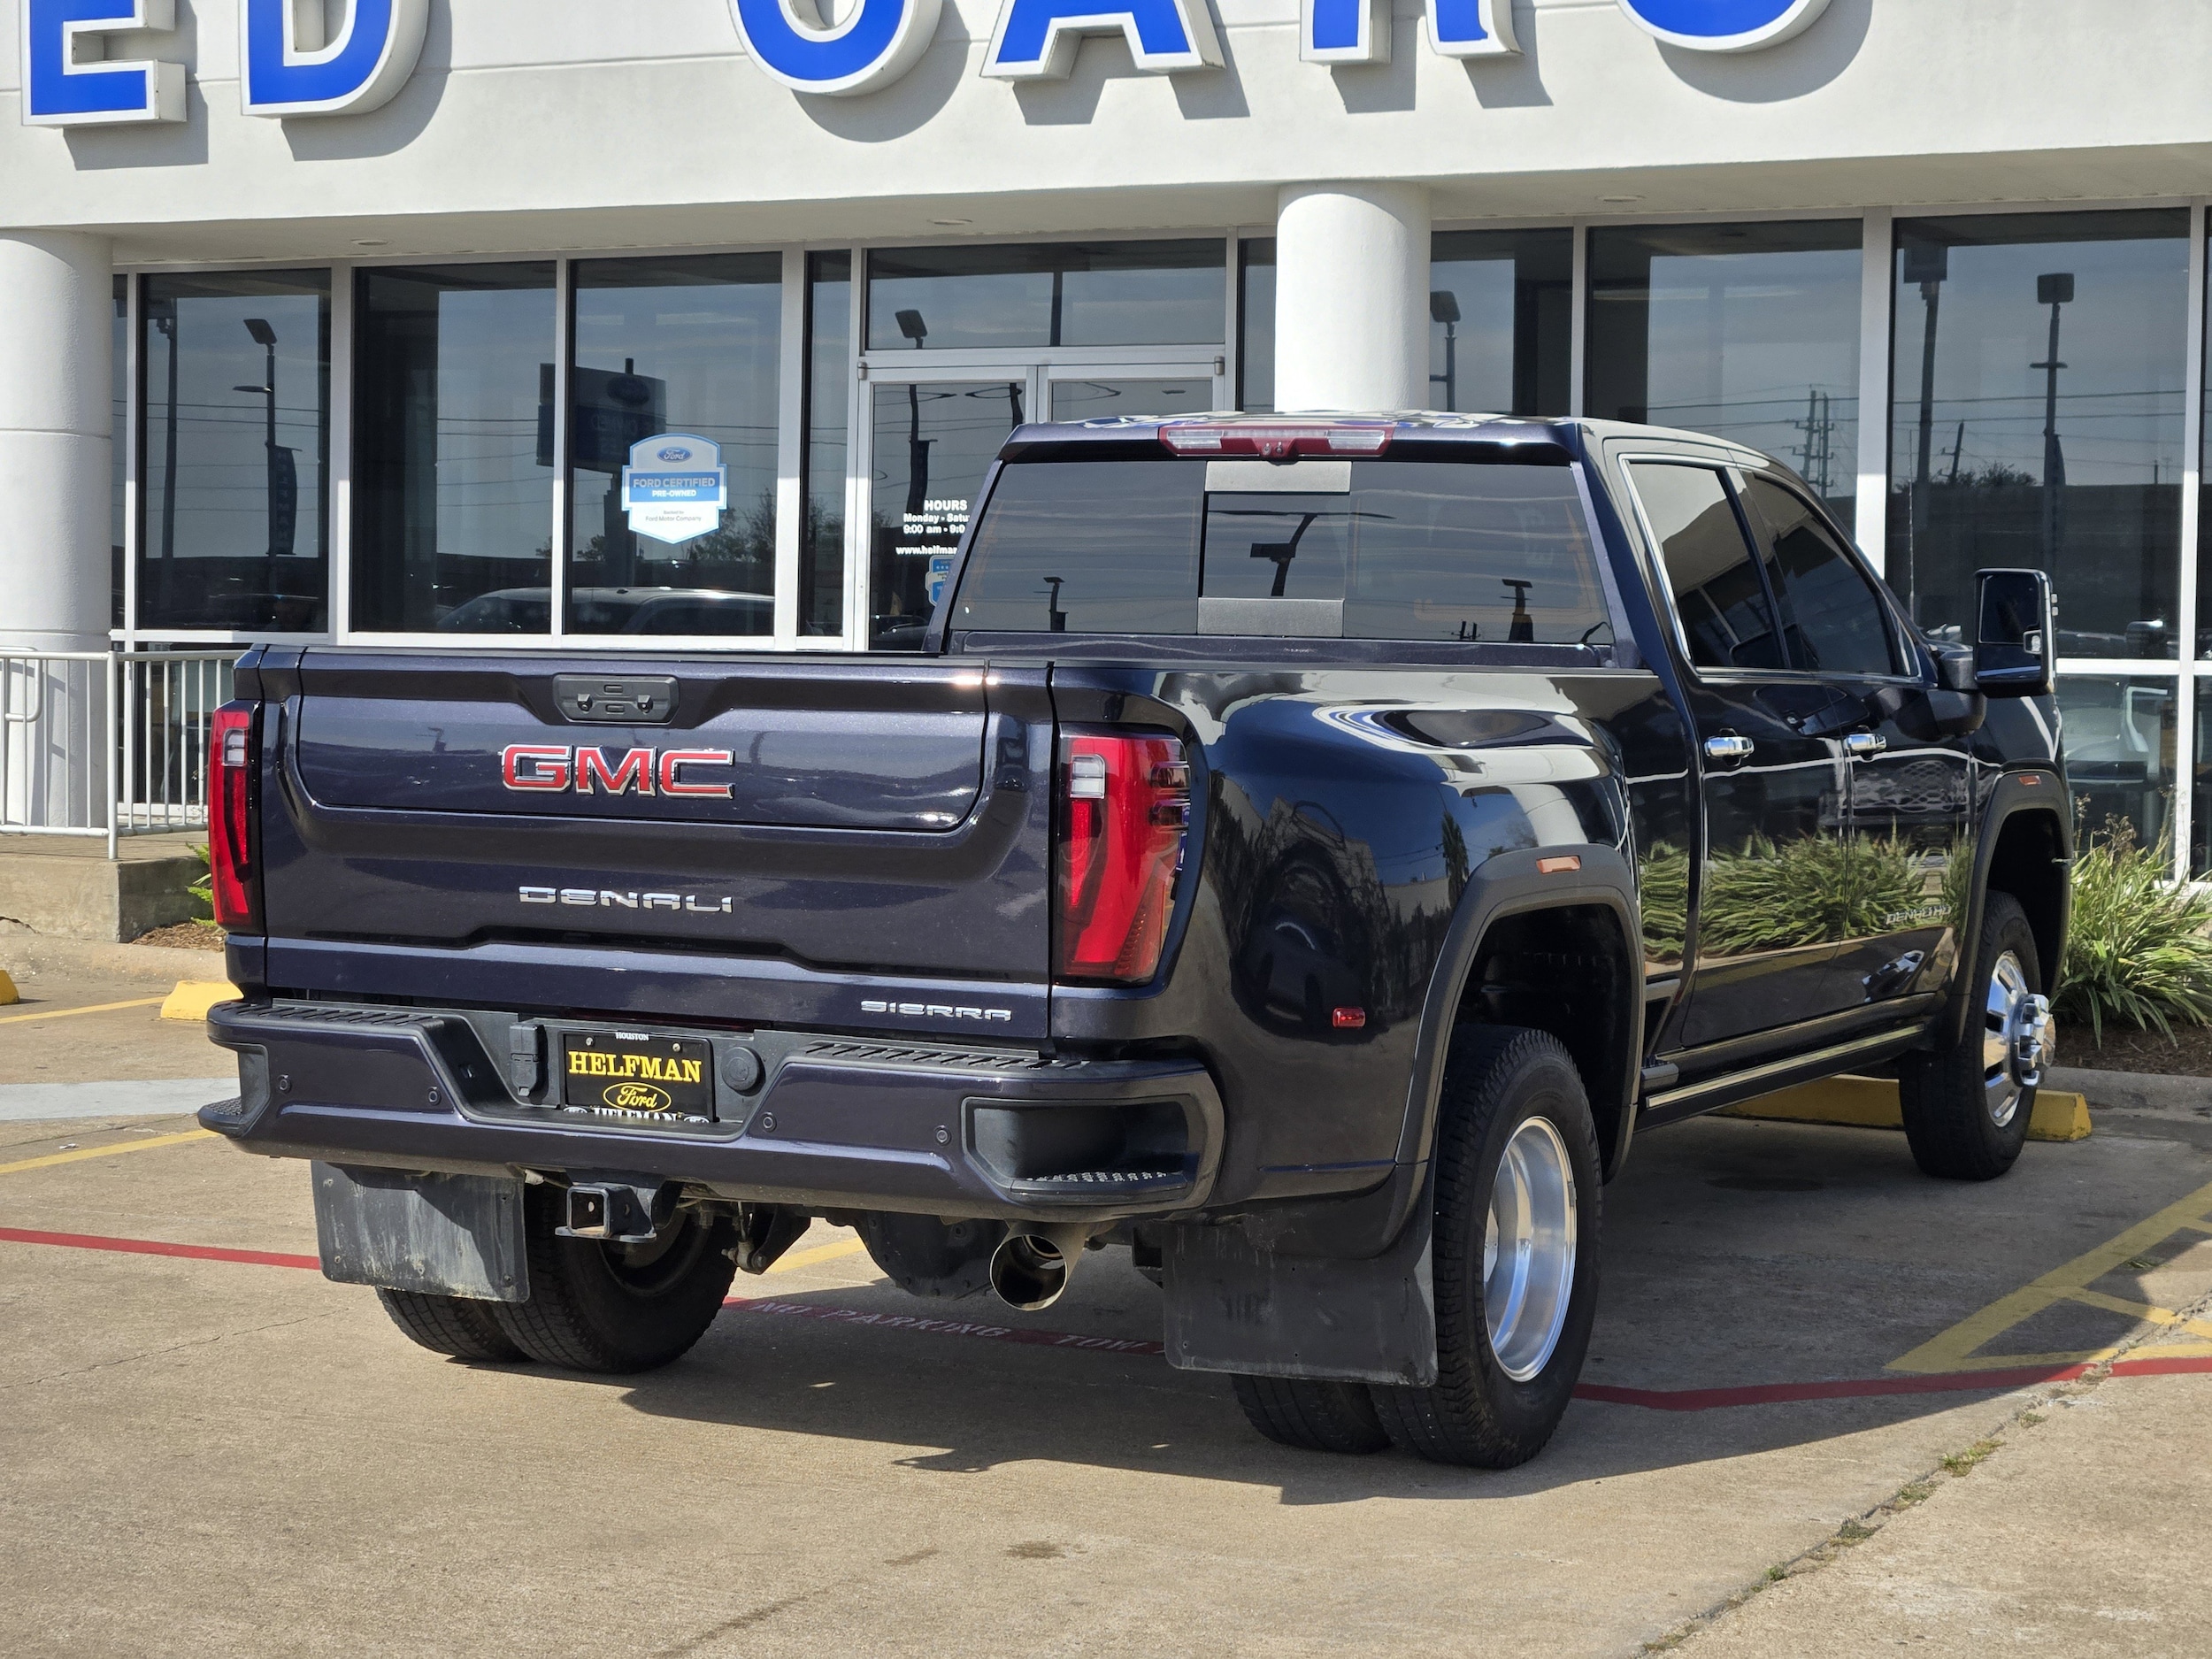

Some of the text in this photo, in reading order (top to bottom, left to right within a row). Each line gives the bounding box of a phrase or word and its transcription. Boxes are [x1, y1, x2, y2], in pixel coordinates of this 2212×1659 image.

[633, 477, 716, 488] FORD CERTIFIED
[924, 499, 968, 511] HOURS
[903, 513, 940, 524] Monday
[903, 524, 924, 534] 9:00
[502, 743, 735, 799] GMC
[518, 886, 733, 914] DENALI
[1886, 906, 1932, 926] DENALI
[860, 1000, 1012, 1022] SIERRA
[615, 1032, 649, 1041] HOUSTON
[568, 1050, 702, 1083] HELFMAN
[617, 1085, 657, 1108] Ford
[749, 1302, 1148, 1350] NO PARKING TOW
